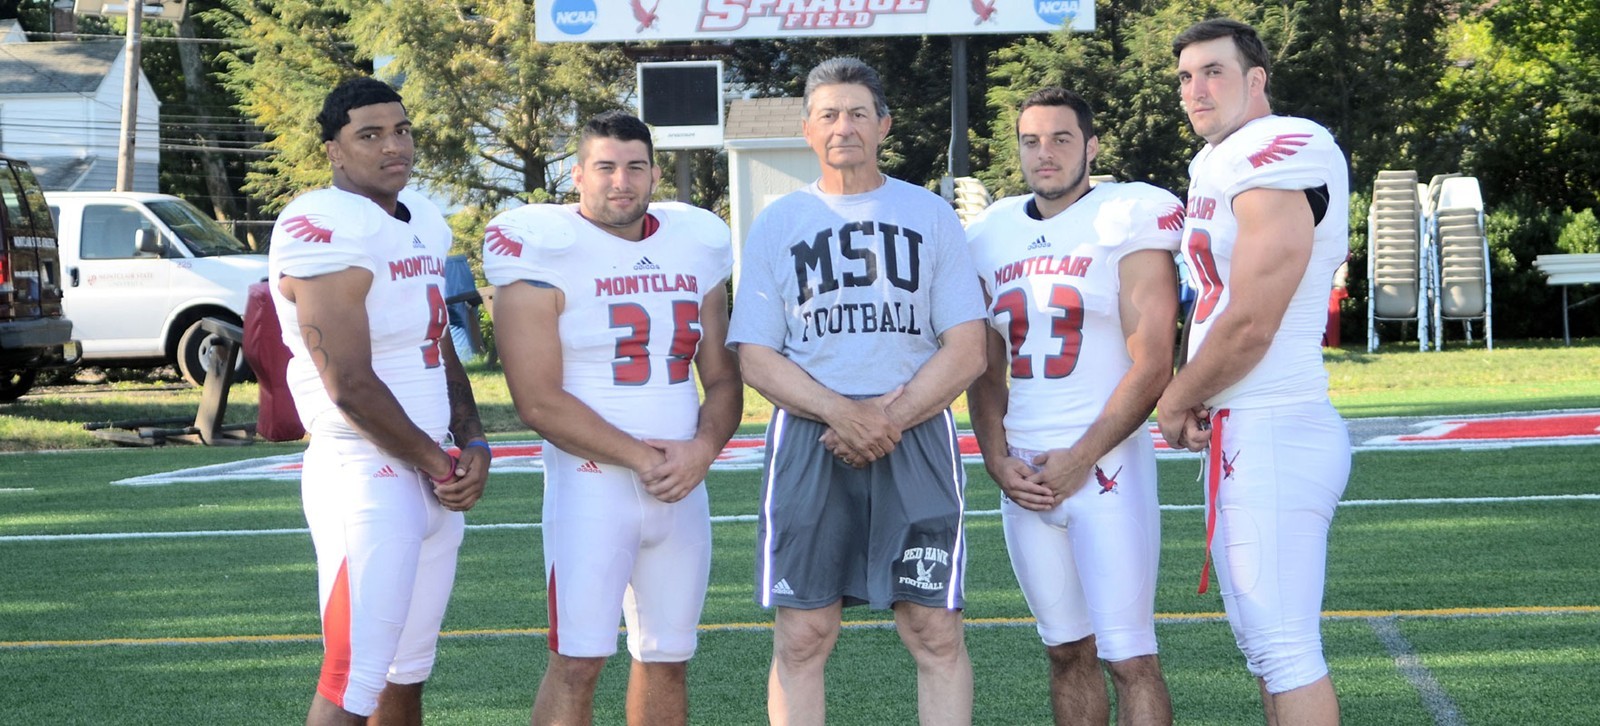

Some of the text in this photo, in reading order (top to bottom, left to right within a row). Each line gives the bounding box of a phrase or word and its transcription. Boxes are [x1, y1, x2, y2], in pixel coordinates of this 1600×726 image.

[1038, 0, 1080, 14] NCAA
[556, 10, 596, 25] NCAA
[784, 12, 871, 28] FIELD
[790, 220, 924, 306] MSU
[994, 255, 1093, 290] MONTCLAIR
[595, 273, 698, 297] MONTCLAIR
[801, 301, 921, 342] FOOTBALL
[993, 283, 1085, 379] 23
[608, 299, 702, 387] 35
[373, 471, 399, 479] adidas
[576, 466, 602, 474] adidas
[902, 547, 949, 566] RED HAWK
[771, 587, 795, 596] adidas
[899, 576, 944, 590] FOOTBALL
